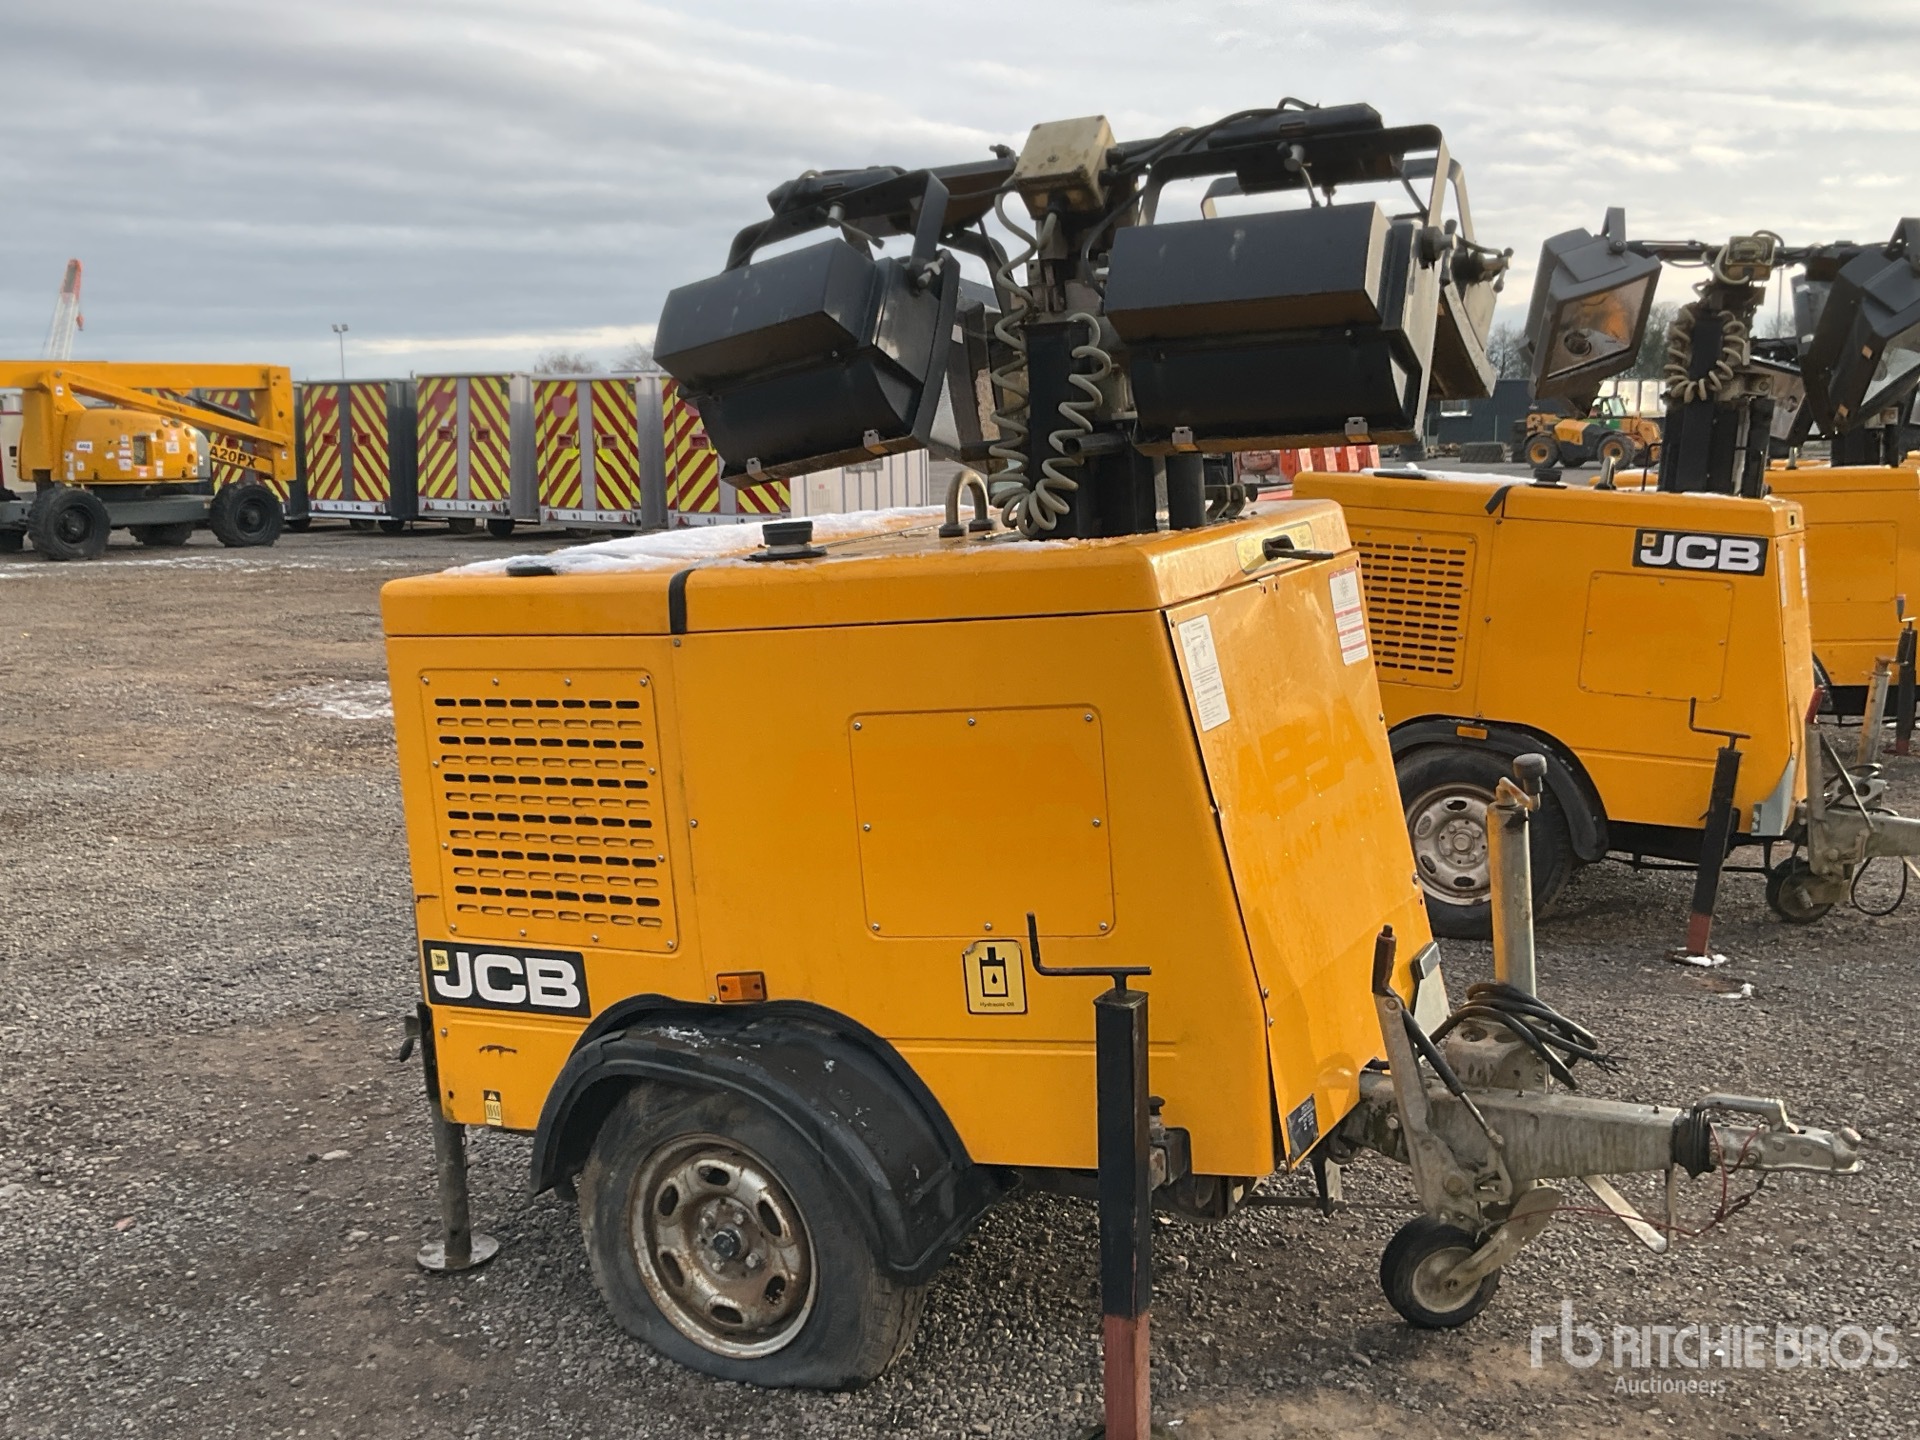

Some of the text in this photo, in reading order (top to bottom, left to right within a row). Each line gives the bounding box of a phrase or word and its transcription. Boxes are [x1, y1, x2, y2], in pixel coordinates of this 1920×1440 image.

[210, 446, 256, 468] A20PX
[1640, 534, 1760, 572] JCB
[1237, 695, 1376, 821] ABBA
[433, 951, 581, 1009] JCB
